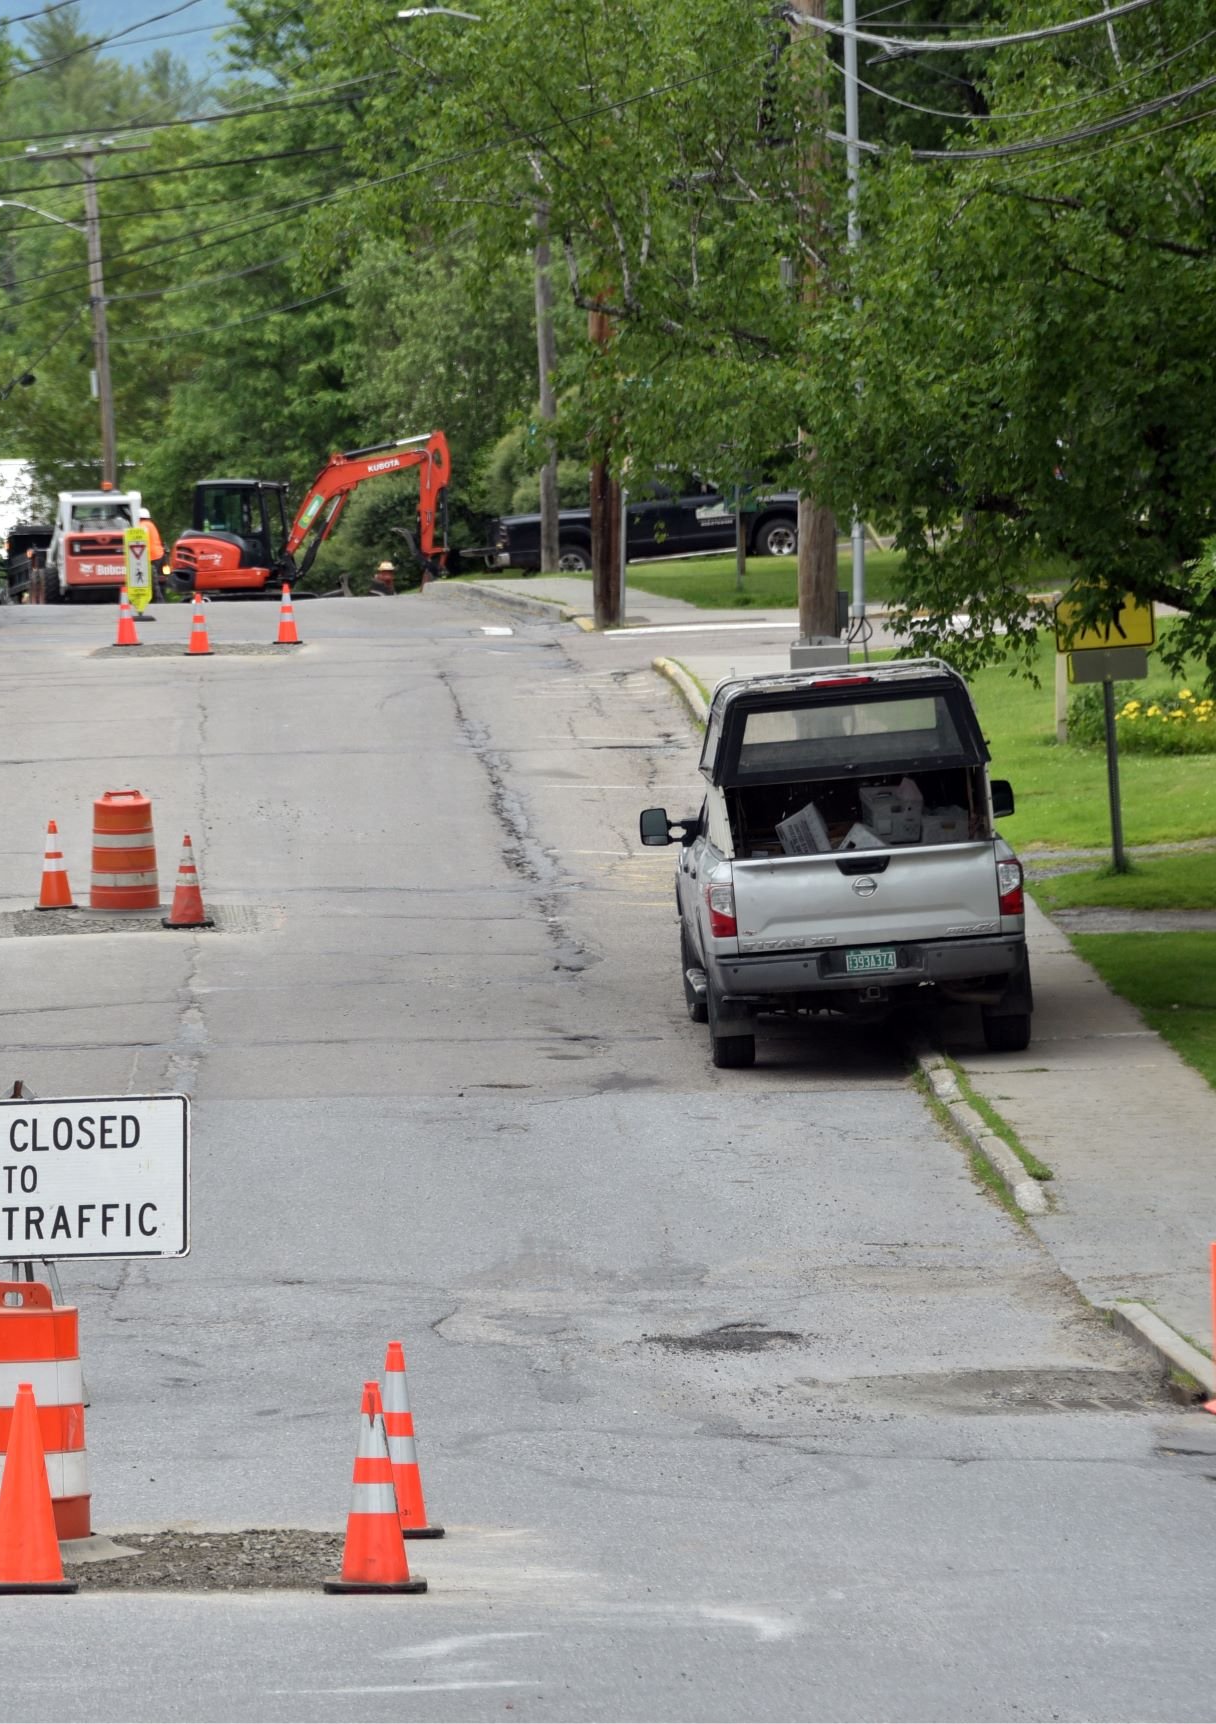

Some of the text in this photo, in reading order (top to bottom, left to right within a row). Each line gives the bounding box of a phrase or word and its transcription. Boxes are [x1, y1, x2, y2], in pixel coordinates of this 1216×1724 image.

[367, 458, 400, 472] KUBOTA
[96, 564, 127, 576] Bobca
[10, 1115, 141, 1152] CLOSED
[3, 1165, 38, 1194] TO
[2, 1202, 159, 1241] TRAFFIC
